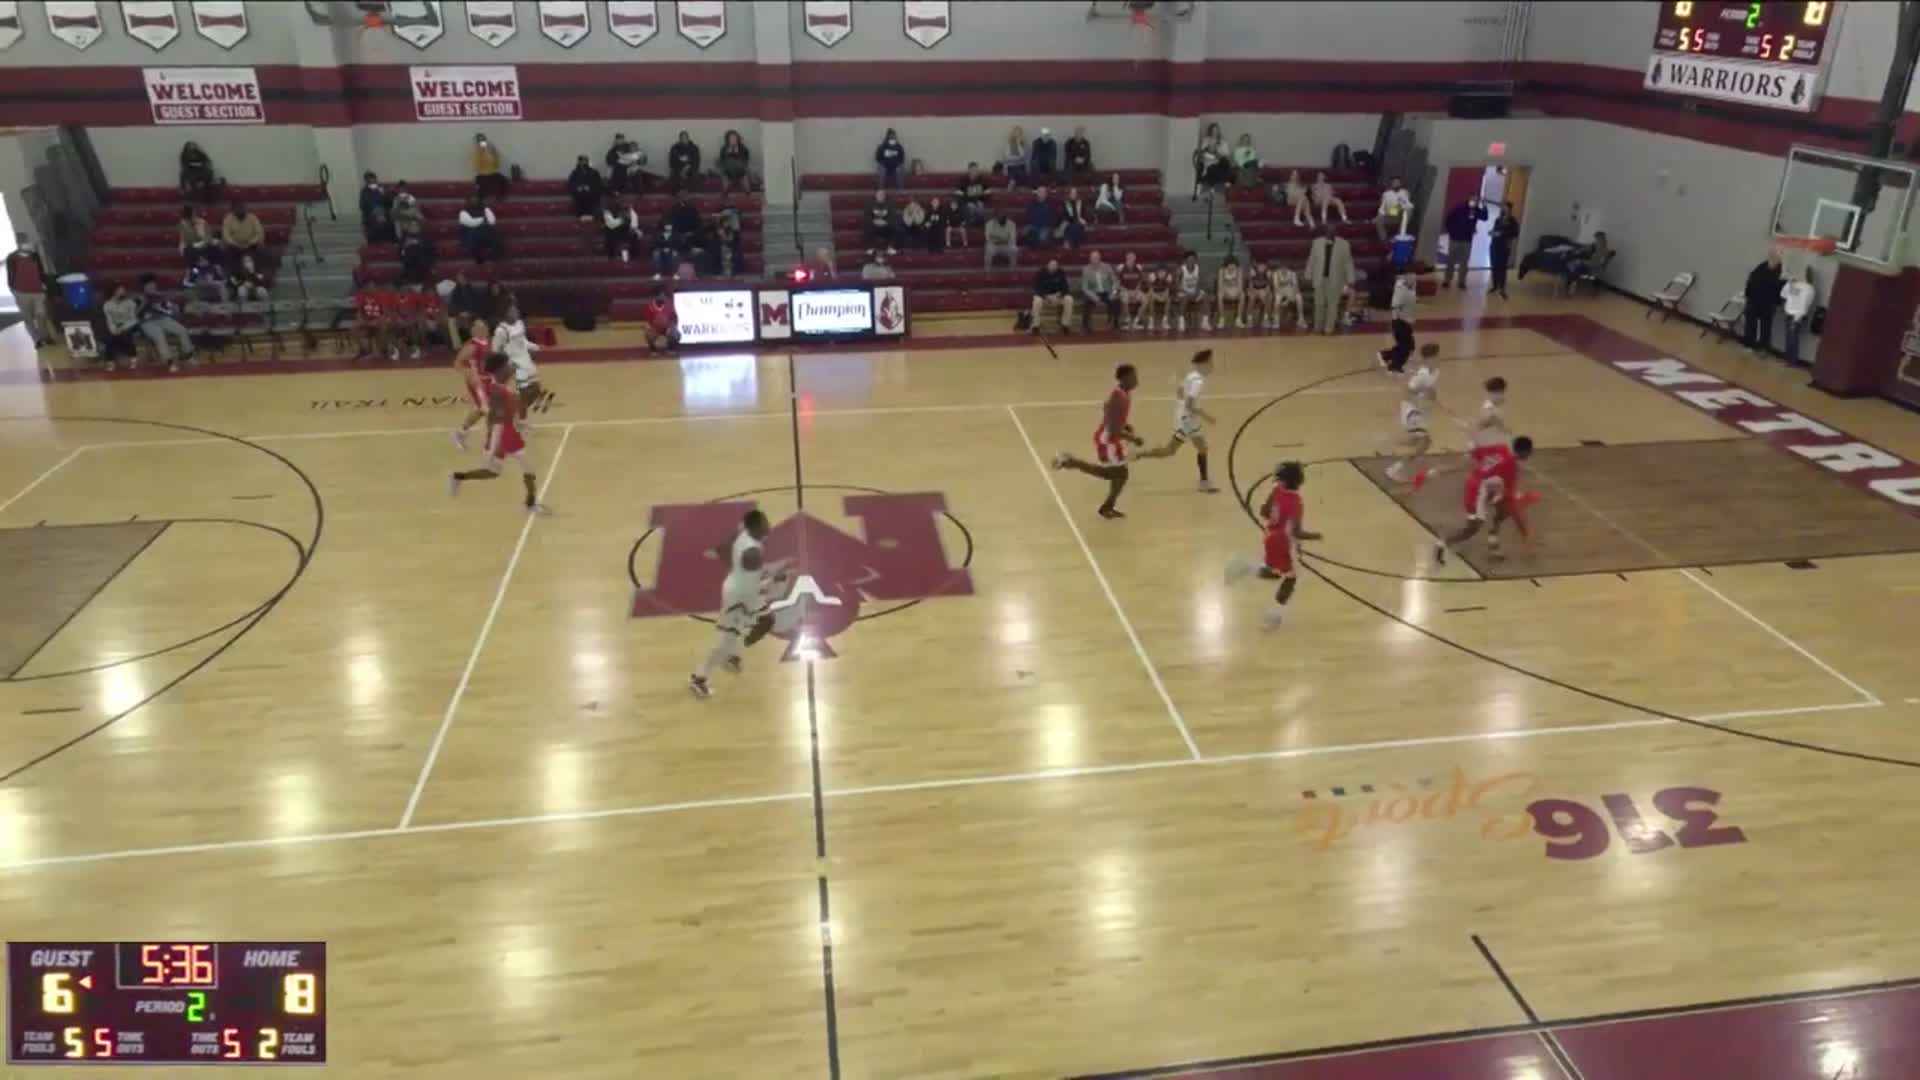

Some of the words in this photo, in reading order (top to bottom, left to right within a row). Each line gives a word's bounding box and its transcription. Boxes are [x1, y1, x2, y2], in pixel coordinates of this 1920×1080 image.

[1747, 3, 1760, 28] 2
[1678, 27, 1691, 50] 5
[1693, 29, 1705, 51] 5
[1760, 34, 1773, 58] 5
[1779, 35, 1795, 60] 2
[152, 83, 257, 100] WELCOME
[416, 81, 516, 97] WELCOME
[1670, 63, 1786, 99] WARRIORS
[160, 105, 200, 118] GUEST
[204, 105, 257, 118] SECTION
[423, 103, 461, 115] GUEST
[464, 103, 513, 115] SECTION
[761, 303, 789, 326] M
[1525, 787, 1748, 860] 316
